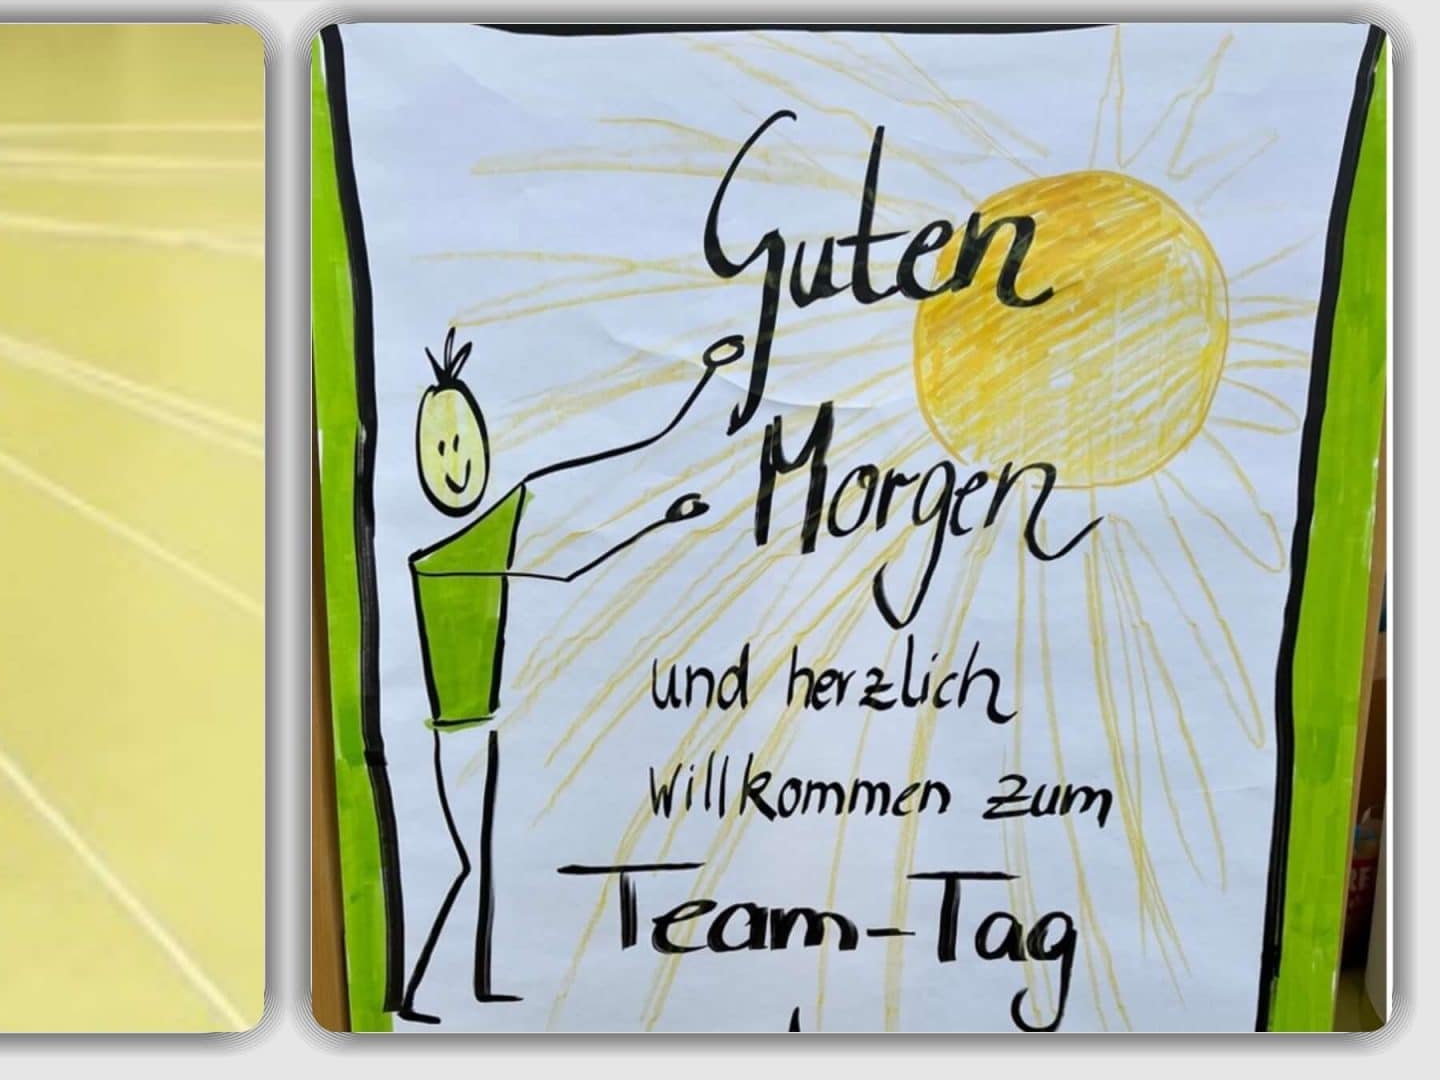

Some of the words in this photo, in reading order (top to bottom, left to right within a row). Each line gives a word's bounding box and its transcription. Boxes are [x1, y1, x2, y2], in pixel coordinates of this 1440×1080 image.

[703, 110, 1055, 435] Guten
[754, 401, 1104, 630] Morgen
[652, 642, 750, 710] und
[786, 634, 1017, 724] herzlich
[982, 774, 1114, 828] zum
[557, 862, 1078, 1032] Team-Tag
